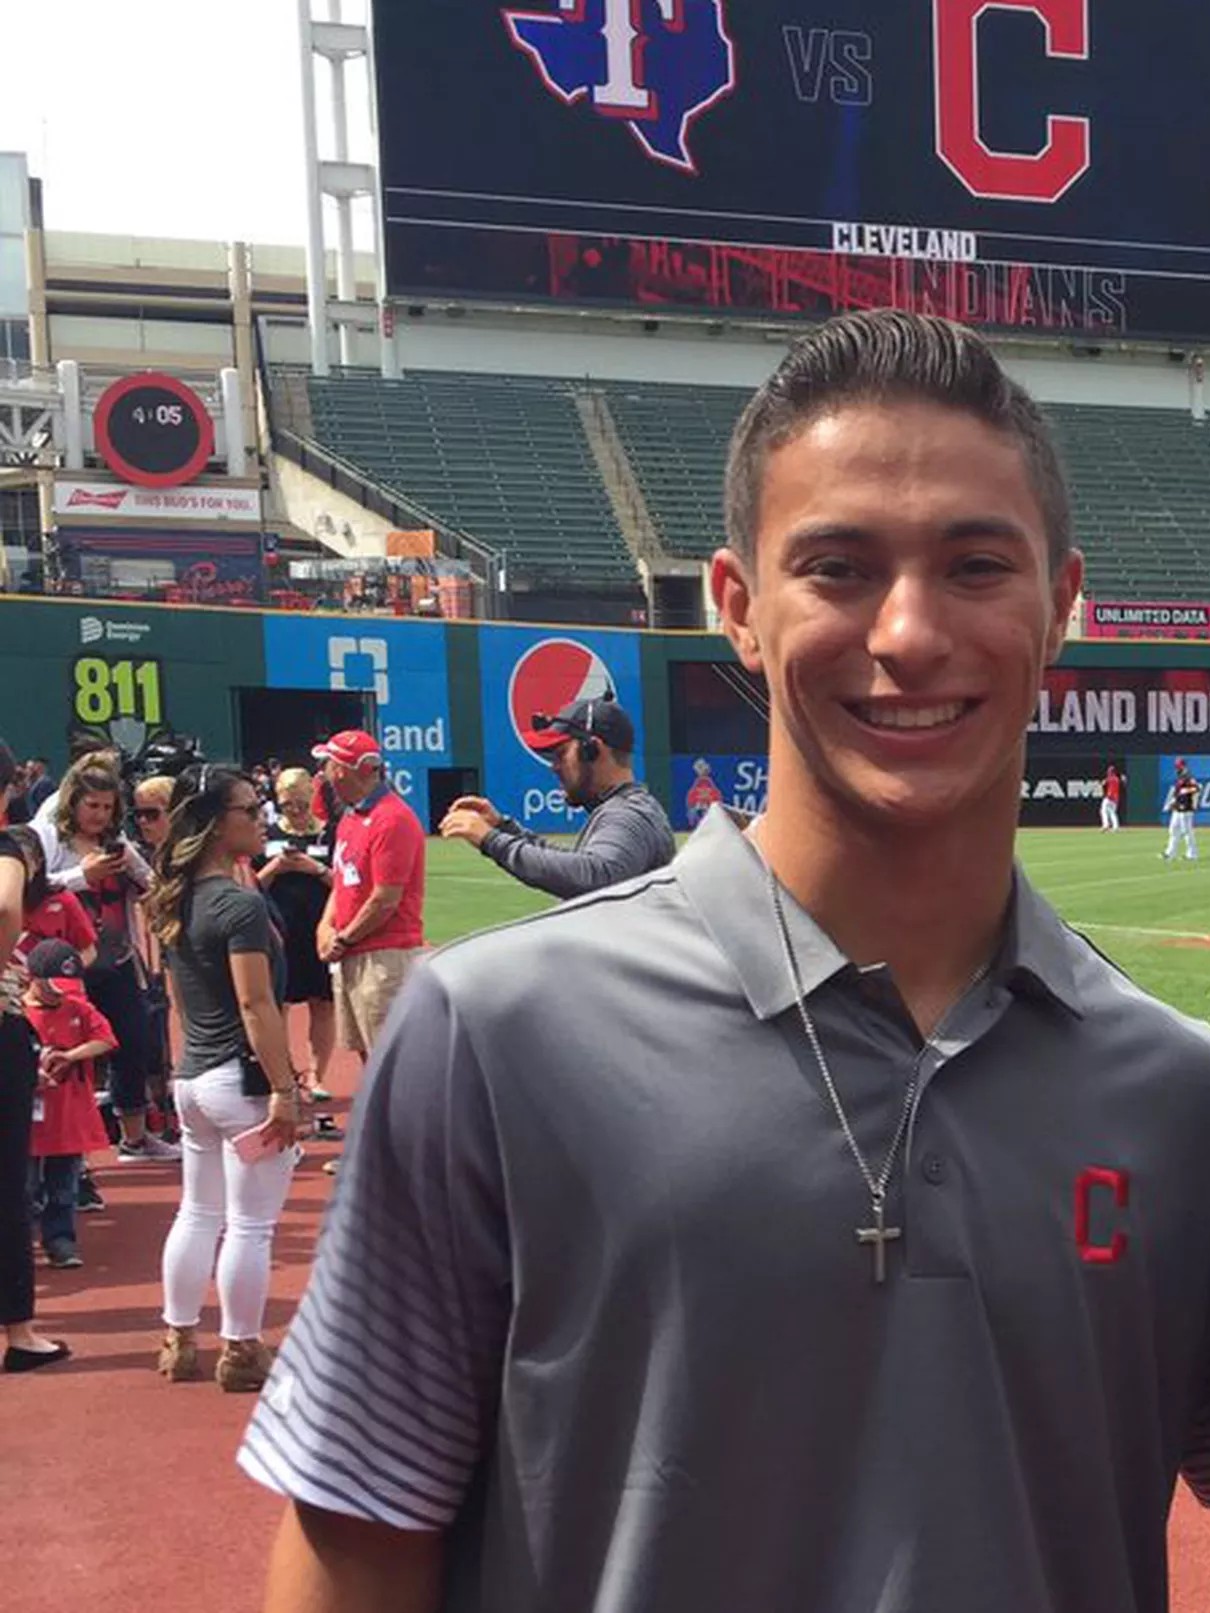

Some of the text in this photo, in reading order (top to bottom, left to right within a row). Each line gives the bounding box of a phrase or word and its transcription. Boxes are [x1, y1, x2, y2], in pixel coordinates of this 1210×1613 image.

[782, 26, 873, 105] VS
[932, 0, 1090, 203] C
[832, 222, 977, 261] CLEVELAND
[1096, 608, 1170, 622] UNLIMITED
[1172, 610, 1206, 623] DATA
[74, 657, 161, 724] 811
[1074, 1166, 1129, 1263] C
